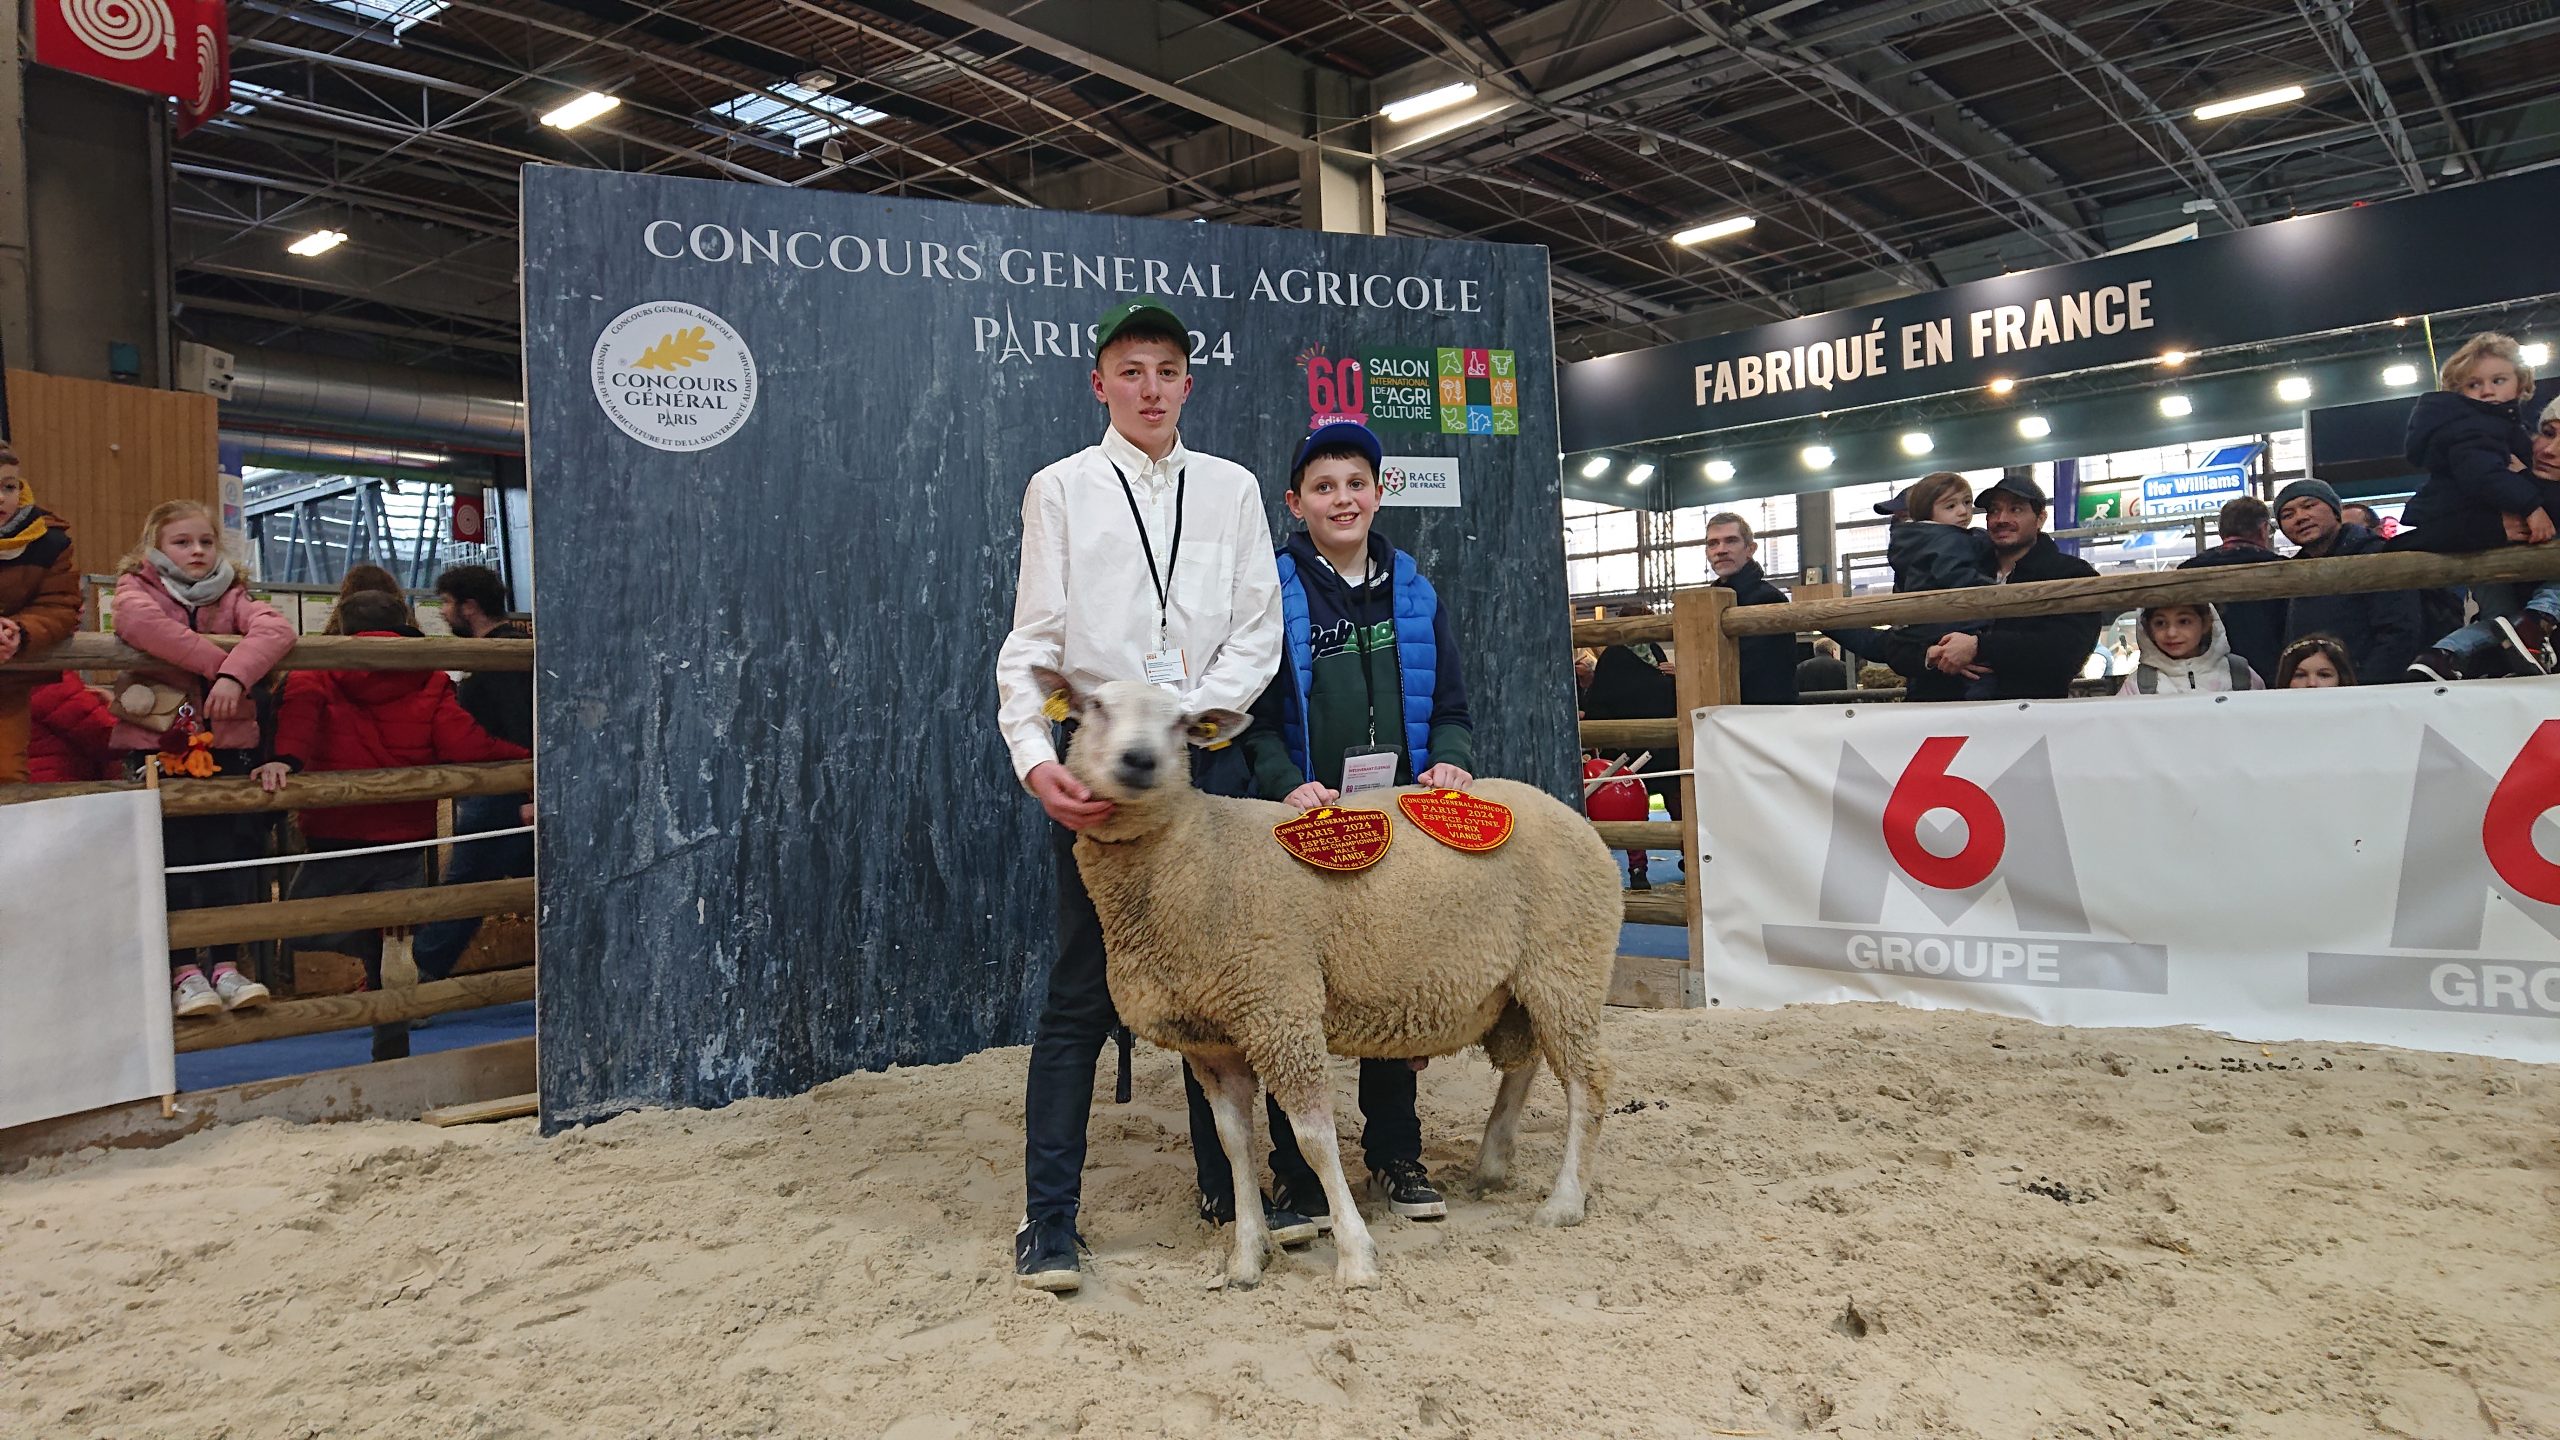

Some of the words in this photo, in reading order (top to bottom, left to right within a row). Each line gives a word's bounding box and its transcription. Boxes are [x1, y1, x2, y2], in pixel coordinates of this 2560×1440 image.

[643, 219, 982, 281] CONCOURS
[1000, 247, 1235, 299] GENERAL
[1248, 267, 1482, 313] AGRICOLE
[611, 307, 653, 335] CONCOURS
[695, 311, 734, 342] AGRICOLE
[973, 299, 1099, 365] PARIS
[1187, 330, 1235, 366] 24
[1694, 316, 1888, 406] FABRIQUÉ
[1901, 318, 1954, 370] EN
[1970, 279, 2155, 358] FRANCE
[1369, 358, 1430, 378] SALON
[612, 372, 738, 393] CONCOURS
[1370, 377, 1430, 388] INTERNATIONAL
[624, 388, 728, 410] GÉNÉRAL
[657, 409, 698, 427] PARIS
[1372, 405, 1432, 420] CULTURE
[661, 438, 673, 446] ET
[674, 439, 688, 447] DE
[688, 438, 700, 447] LA
[1409, 472, 1446, 483] RACES
[1420, 482, 1447, 490] FRANCE
[2174, 473, 2241, 495] Williams
[2150, 499, 2226, 514] Trailer
[1402, 797, 1439, 805] CONCOURS
[1473, 803, 1509, 814] AGRICOLE
[1421, 805, 1458, 815] PARIS
[1467, 809, 1495, 819] 2024
[1276, 822, 1314, 836] CONCOURS
[1314, 817, 1347, 827] GENERAL
[1348, 813, 1385, 822] AGRICOLE
[1296, 827, 1335, 840] PARIS
[1343, 821, 1372, 832] 2024
[1465, 818, 1500, 828] OVINE
[1330, 837, 1383, 850] CHAMPIONNAT
[1343, 830, 1380, 841] OVINE
[1449, 831, 1484, 842] VIANDE
[1330, 851, 1369, 863] VIANDE
[1845, 934, 2060, 983] GROUPE
